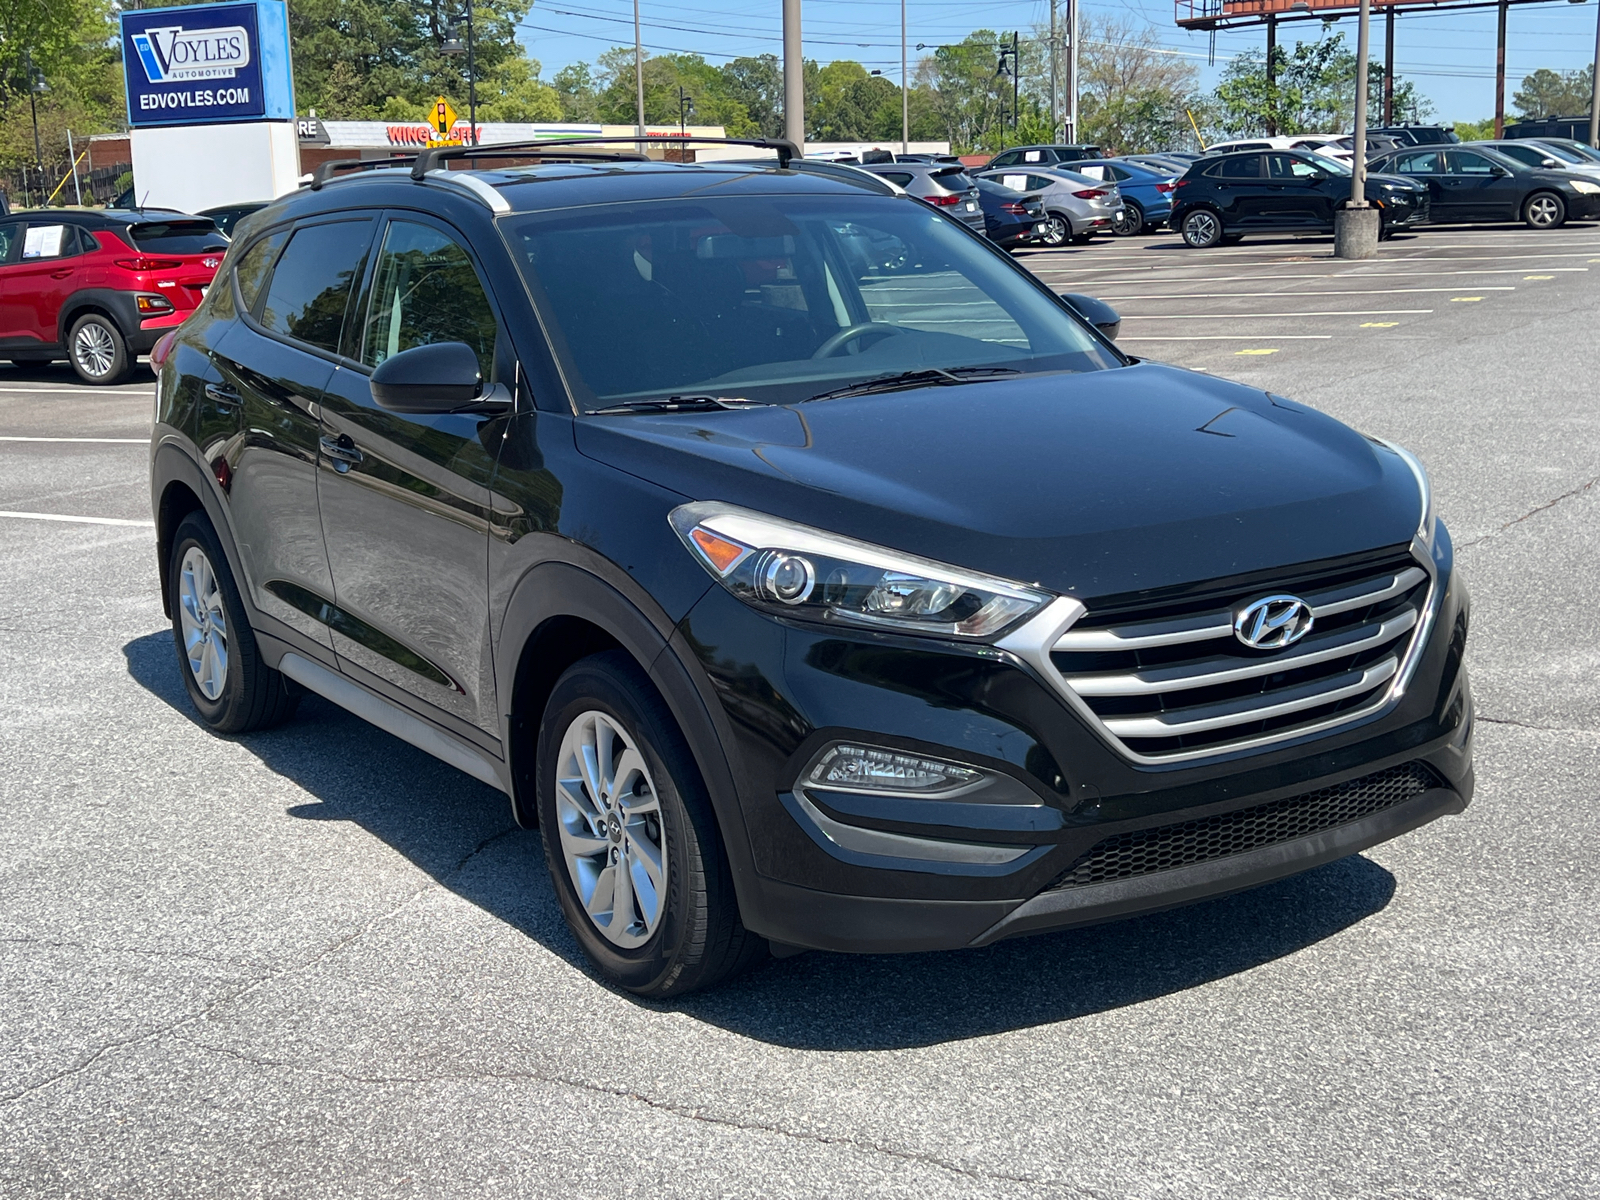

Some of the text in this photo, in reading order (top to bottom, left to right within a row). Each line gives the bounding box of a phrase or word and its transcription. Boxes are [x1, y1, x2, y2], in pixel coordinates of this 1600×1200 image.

[140, 30, 241, 75] ED VOYLES
[172, 68, 233, 79] AUTOMOTIVE
[140, 87, 249, 110] EDVOYLES.COM
[297, 121, 317, 135] RE
[386, 126, 430, 142] WING
